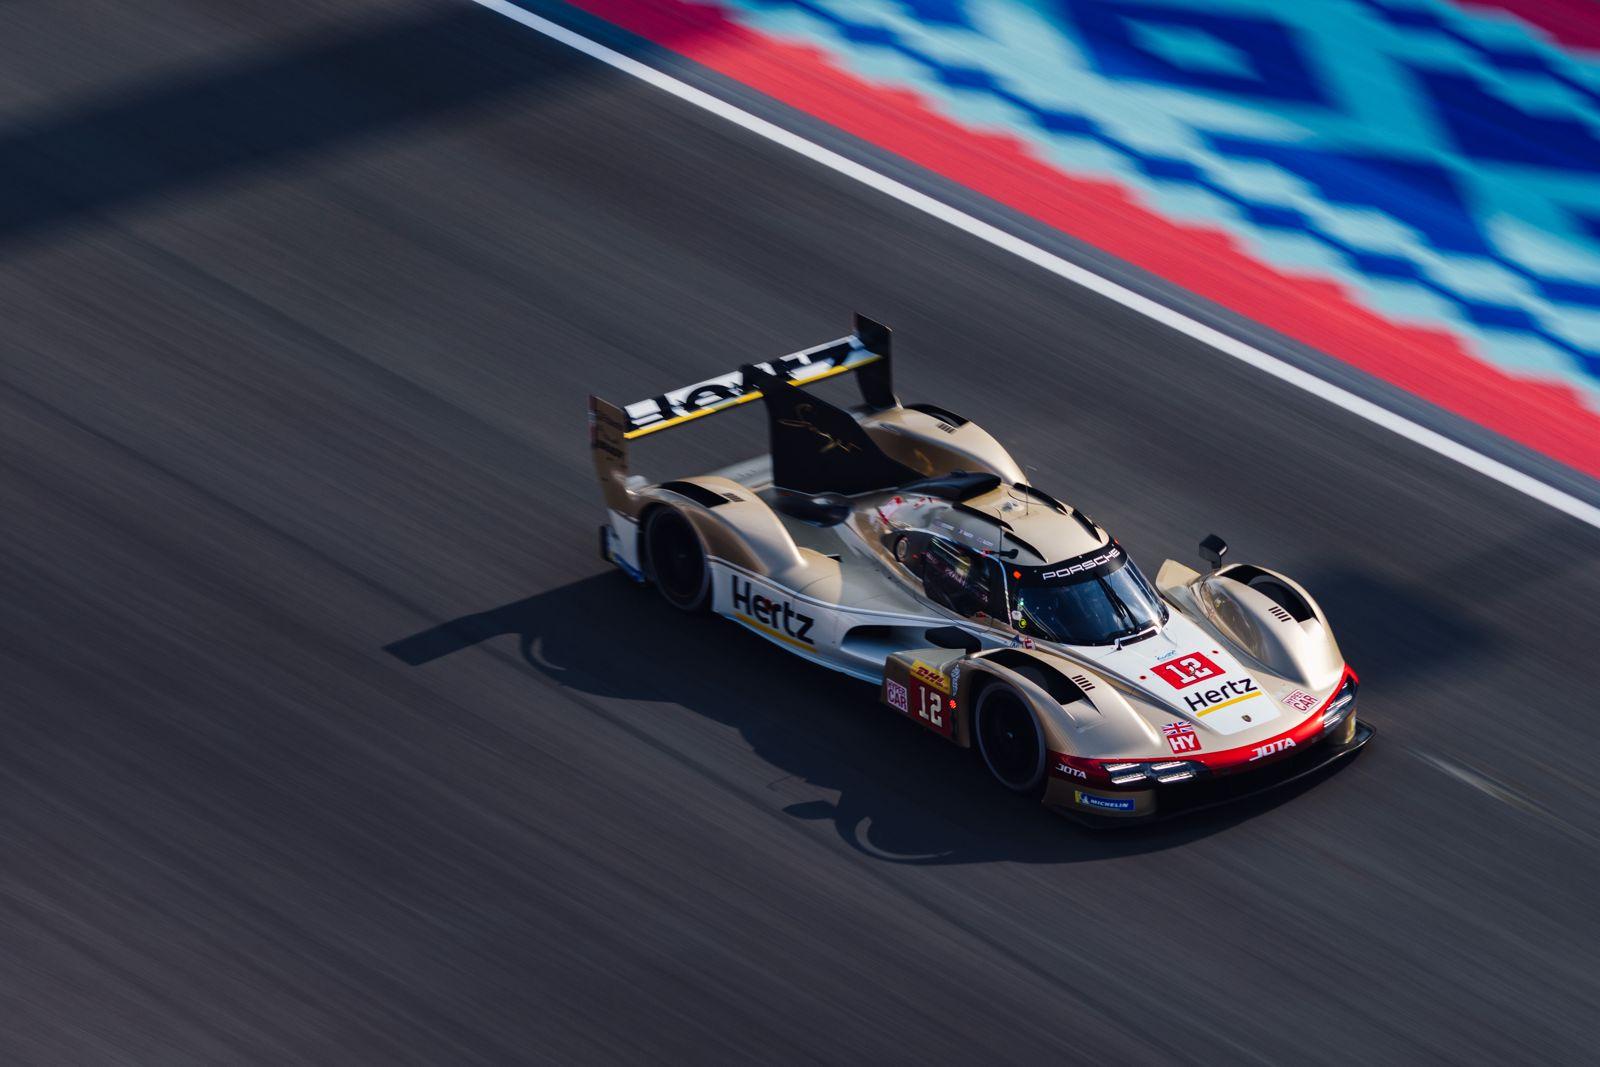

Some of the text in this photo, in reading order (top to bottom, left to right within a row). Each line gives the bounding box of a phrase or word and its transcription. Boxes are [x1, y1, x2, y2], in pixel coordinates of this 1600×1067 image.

[1043, 548, 1120, 580] PORSCHE
[732, 575, 815, 645] Hertz
[916, 666, 945, 688] DHL
[1165, 657, 1214, 684] 12
[889, 687, 908, 710] CAR
[1183, 678, 1258, 712] Hertz
[1293, 695, 1318, 711] CAR
[919, 686, 942, 728] 12
[1169, 734, 1195, 751] HY
[1249, 738, 1296, 761] JOTA
[1055, 763, 1087, 779] JOTA
[1090, 799, 1129, 808] MICHELIN
